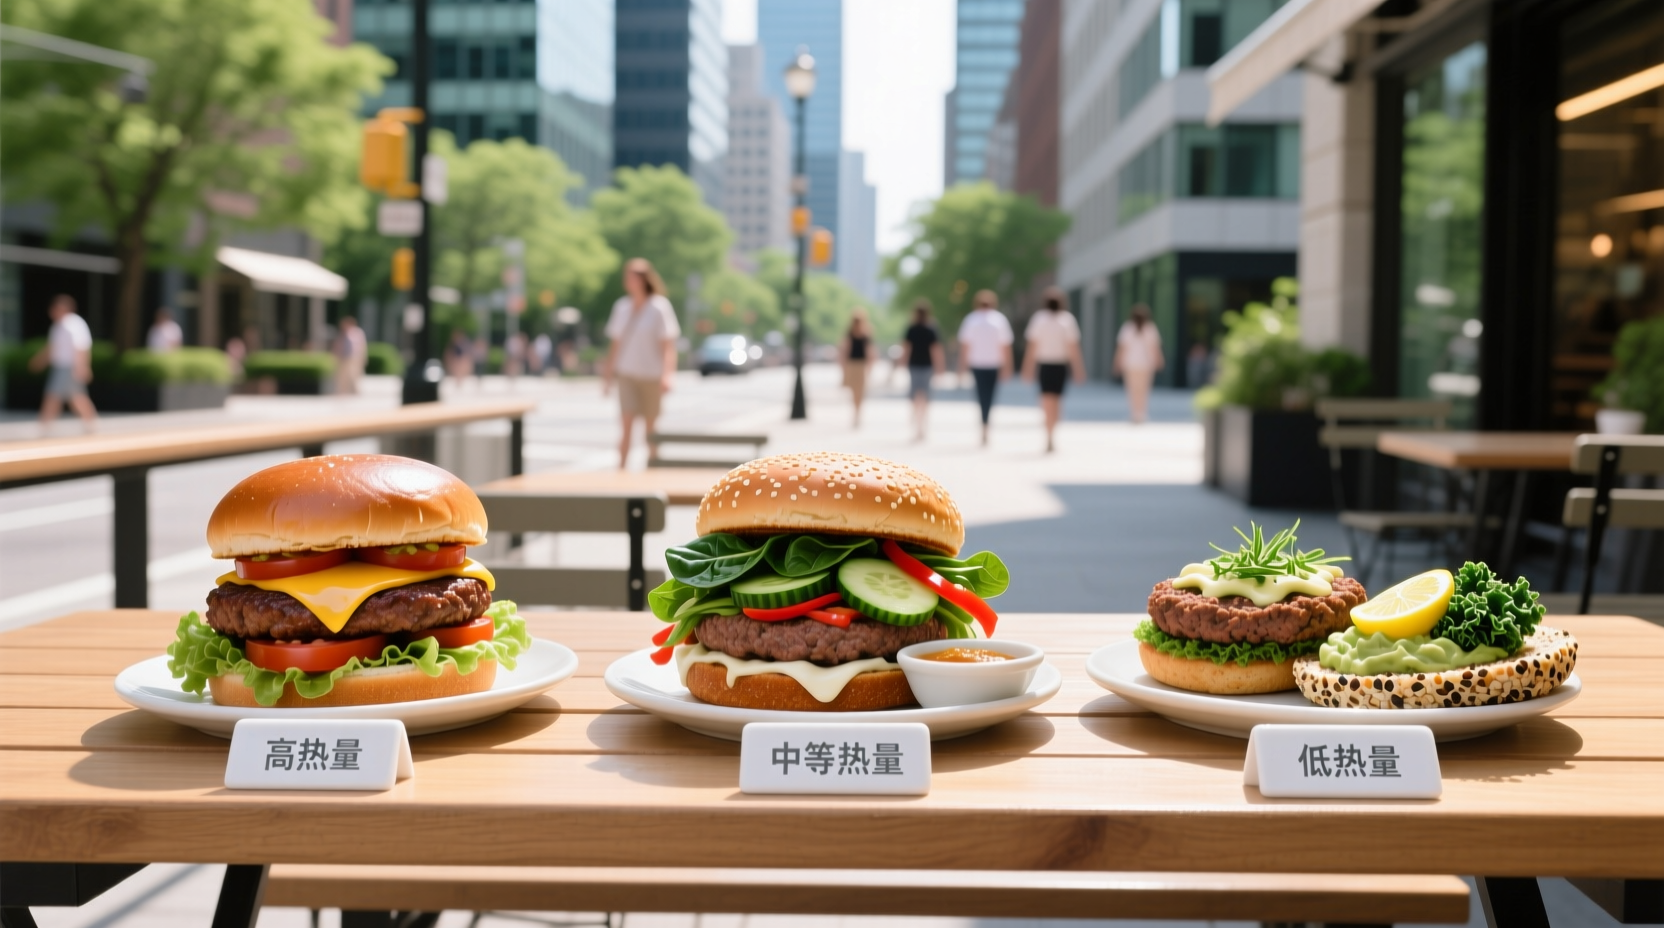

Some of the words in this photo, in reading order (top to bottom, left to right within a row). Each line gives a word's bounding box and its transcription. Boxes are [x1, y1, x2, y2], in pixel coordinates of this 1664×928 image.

[264, 738, 363, 771] 高热量
[771, 741, 904, 775] 中等热量
[1297, 743, 1402, 777] 低热量
